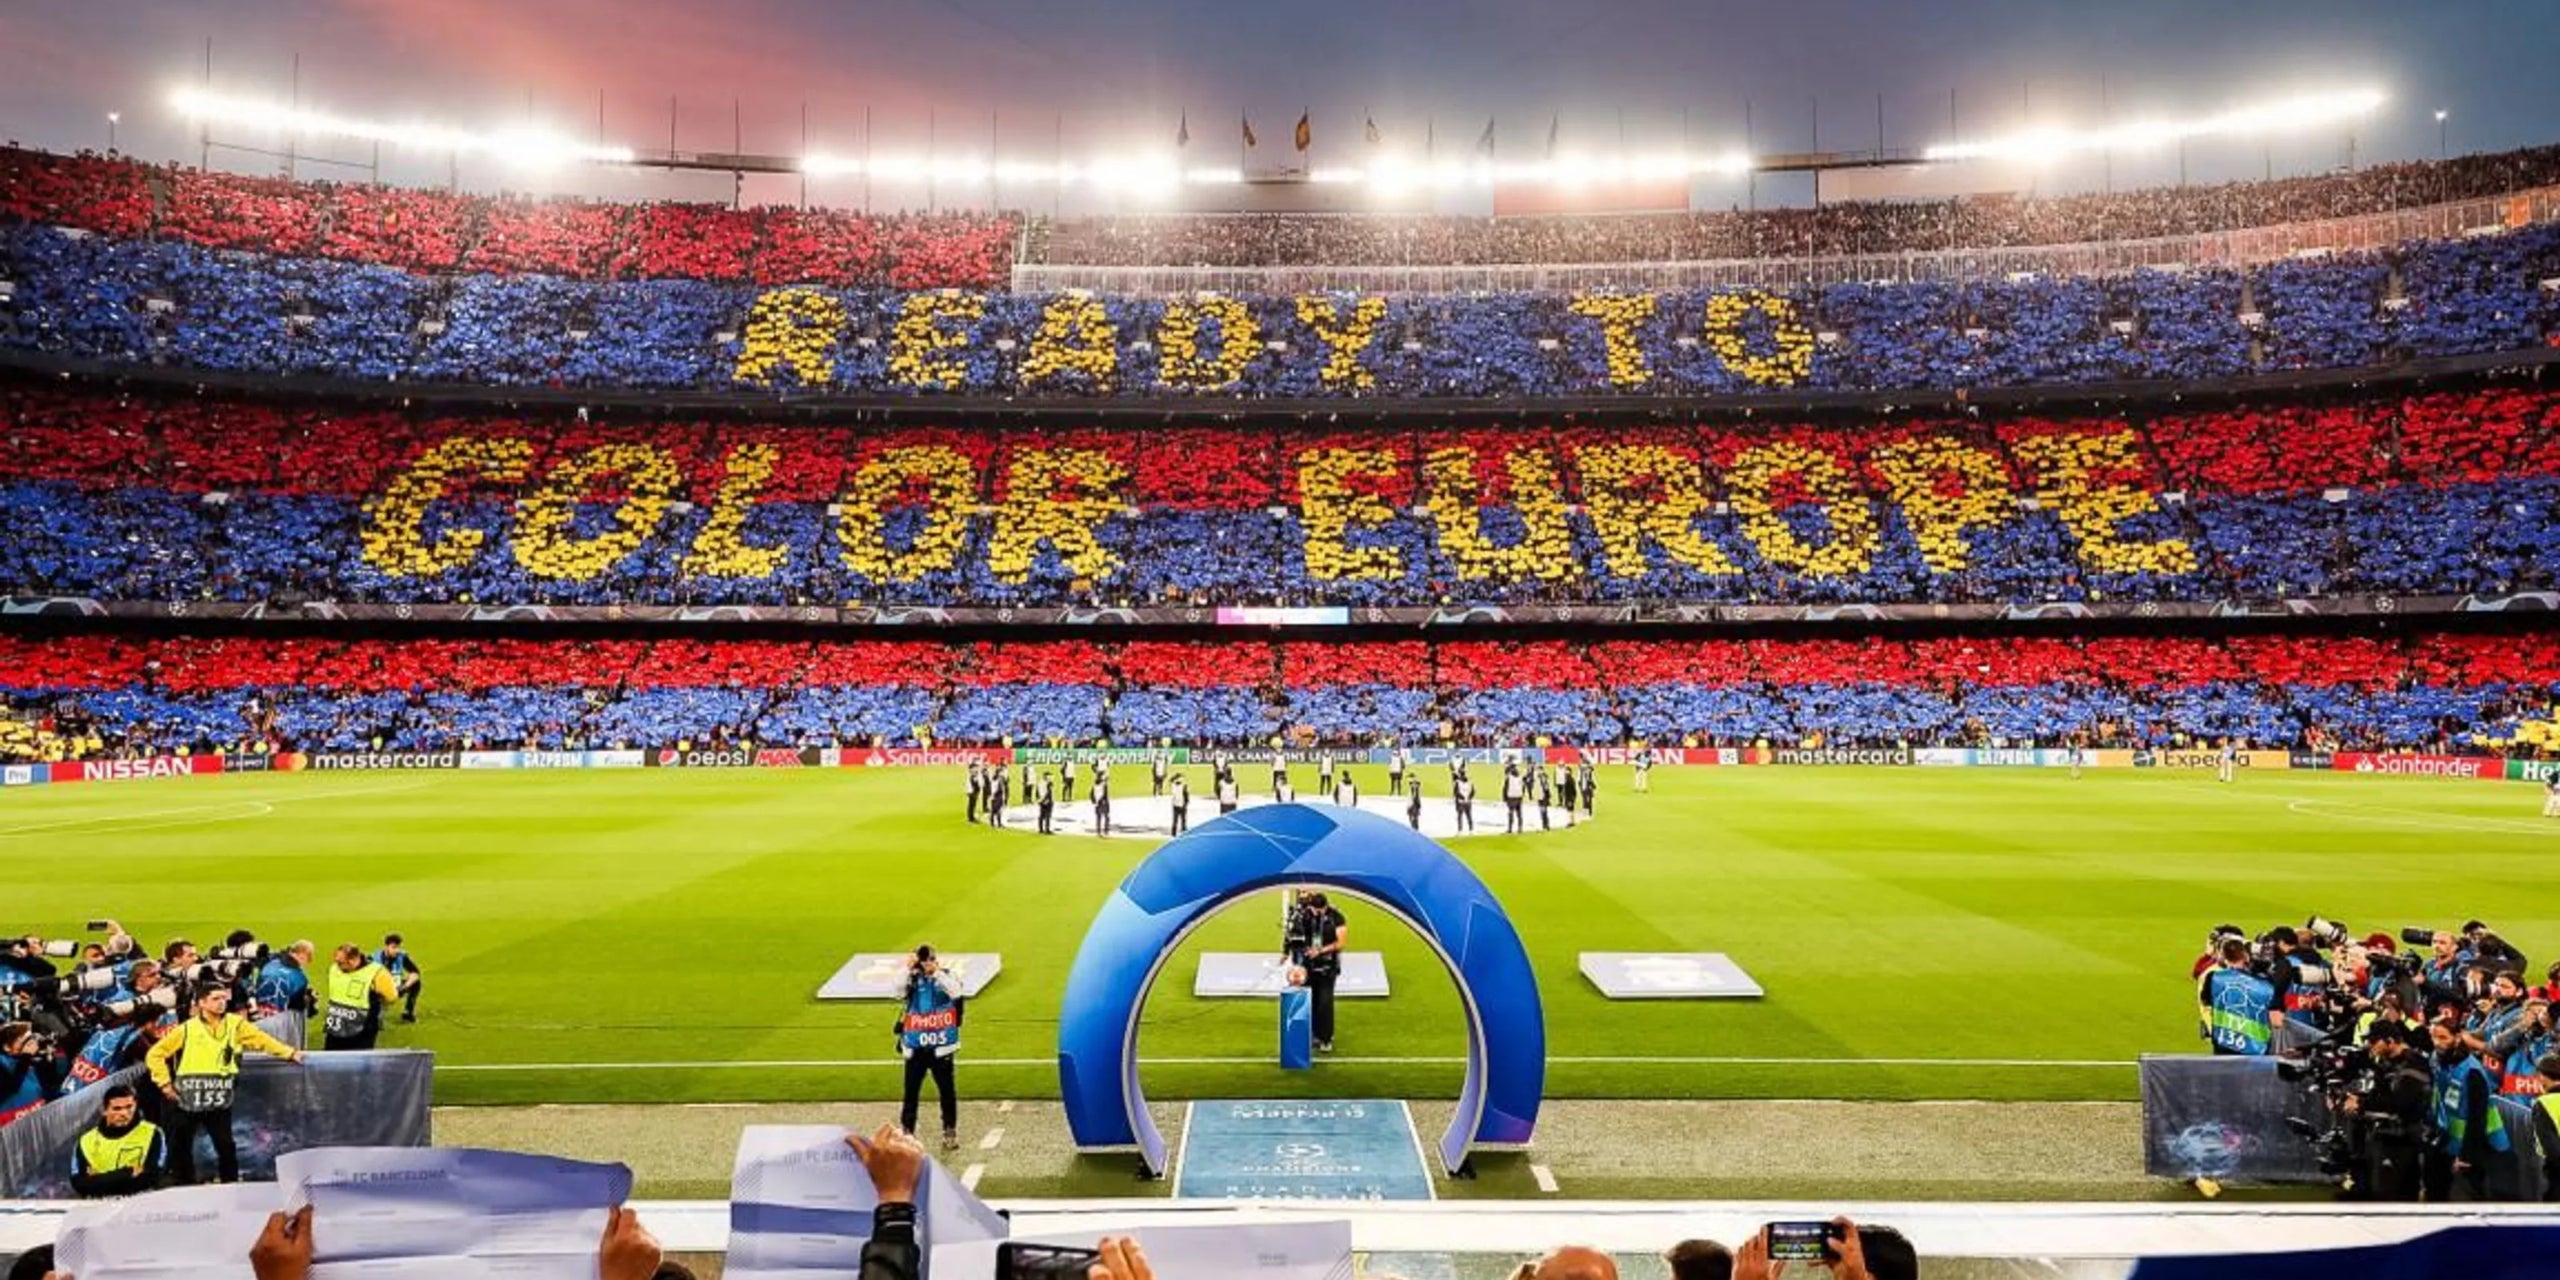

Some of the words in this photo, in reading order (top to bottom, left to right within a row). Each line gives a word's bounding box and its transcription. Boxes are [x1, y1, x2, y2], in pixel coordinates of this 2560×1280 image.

[735, 289, 1389, 390] READY
[1568, 291, 1815, 388] TO
[360, 436, 1132, 583] COLOR
[1298, 428, 2196, 583] EUROPE
[315, 753, 453, 769] mastercard
[1778, 748, 1907, 765] mastercard
[2377, 753, 2481, 778] Santander
[84, 757, 192, 781] NISSAN
[911, 1013, 953, 1030] PHOTO
[193, 1090, 226, 1106] 155
